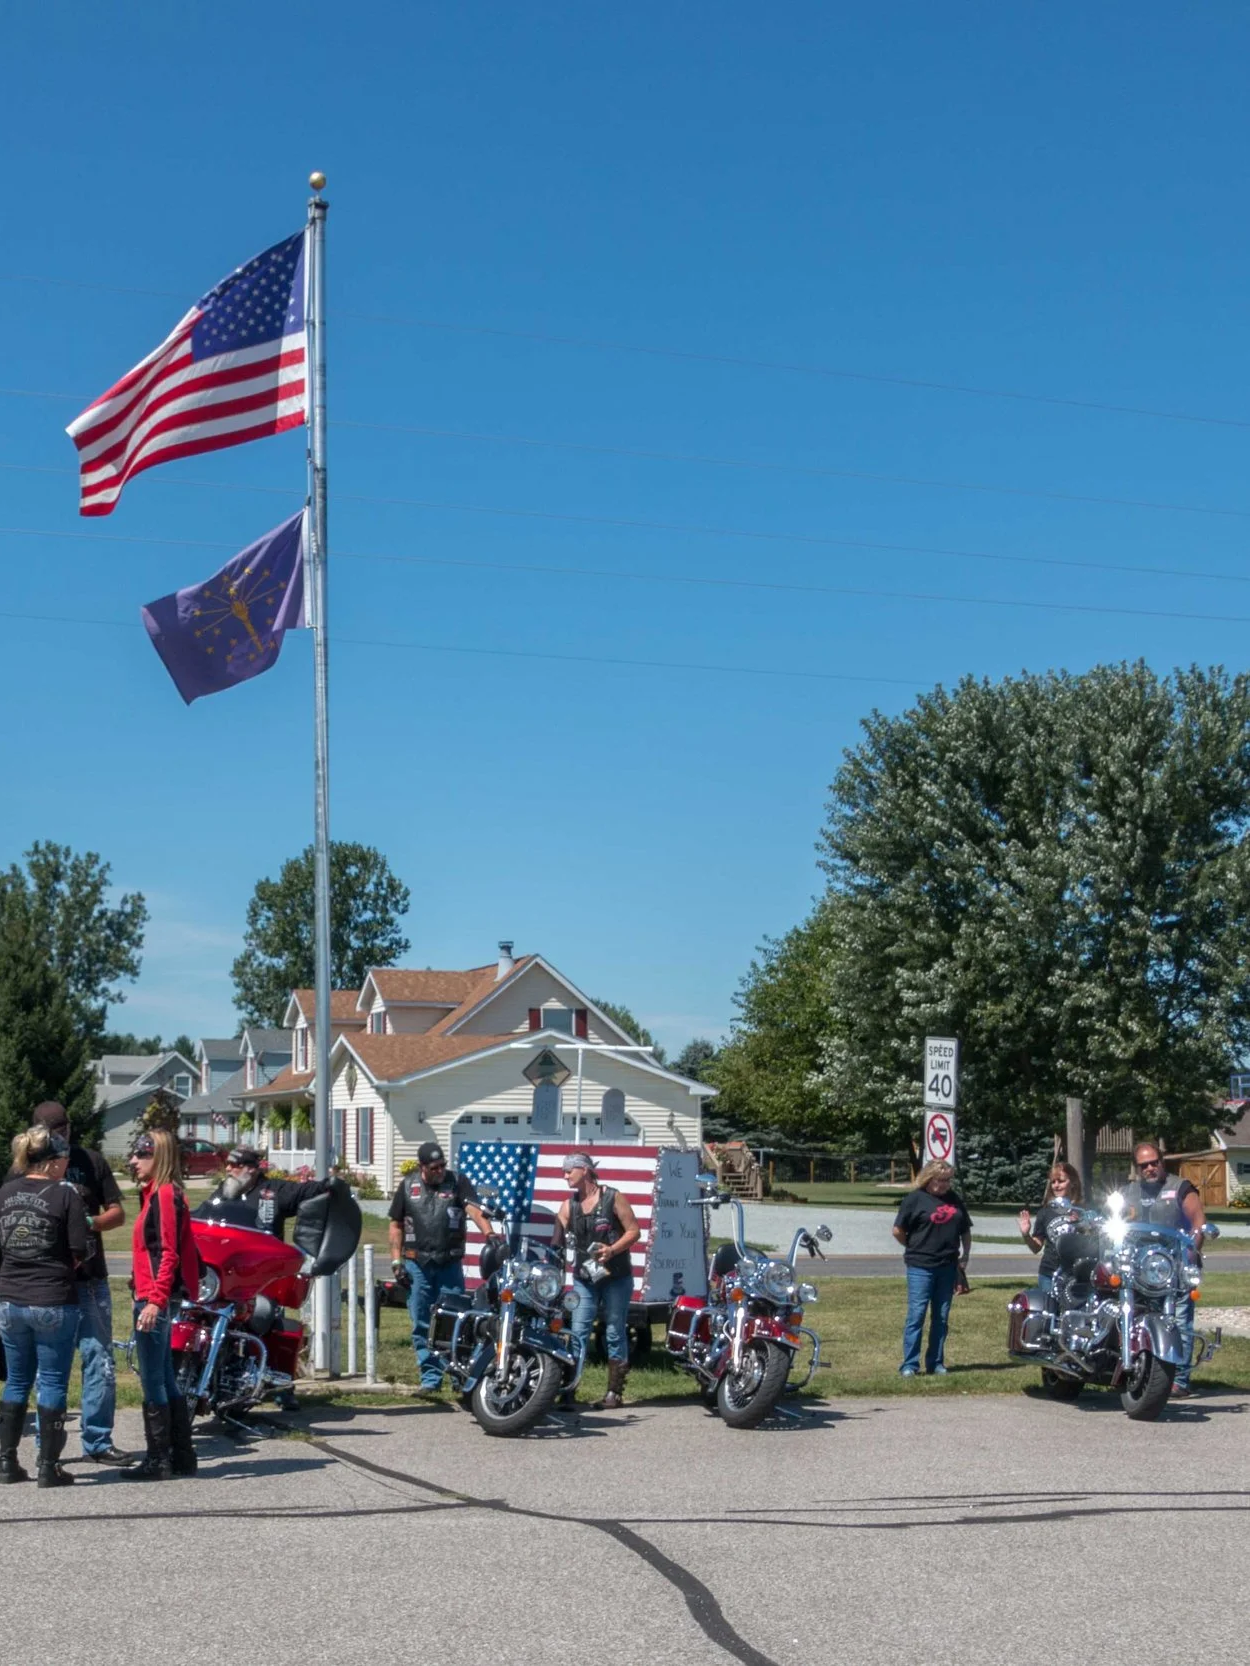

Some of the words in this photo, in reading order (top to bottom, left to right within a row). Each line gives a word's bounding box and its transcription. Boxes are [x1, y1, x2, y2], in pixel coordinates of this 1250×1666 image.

[928, 1045, 954, 1057] SPEED
[930, 1060, 950, 1070] LIMIT
[928, 1073, 952, 1098] 40
